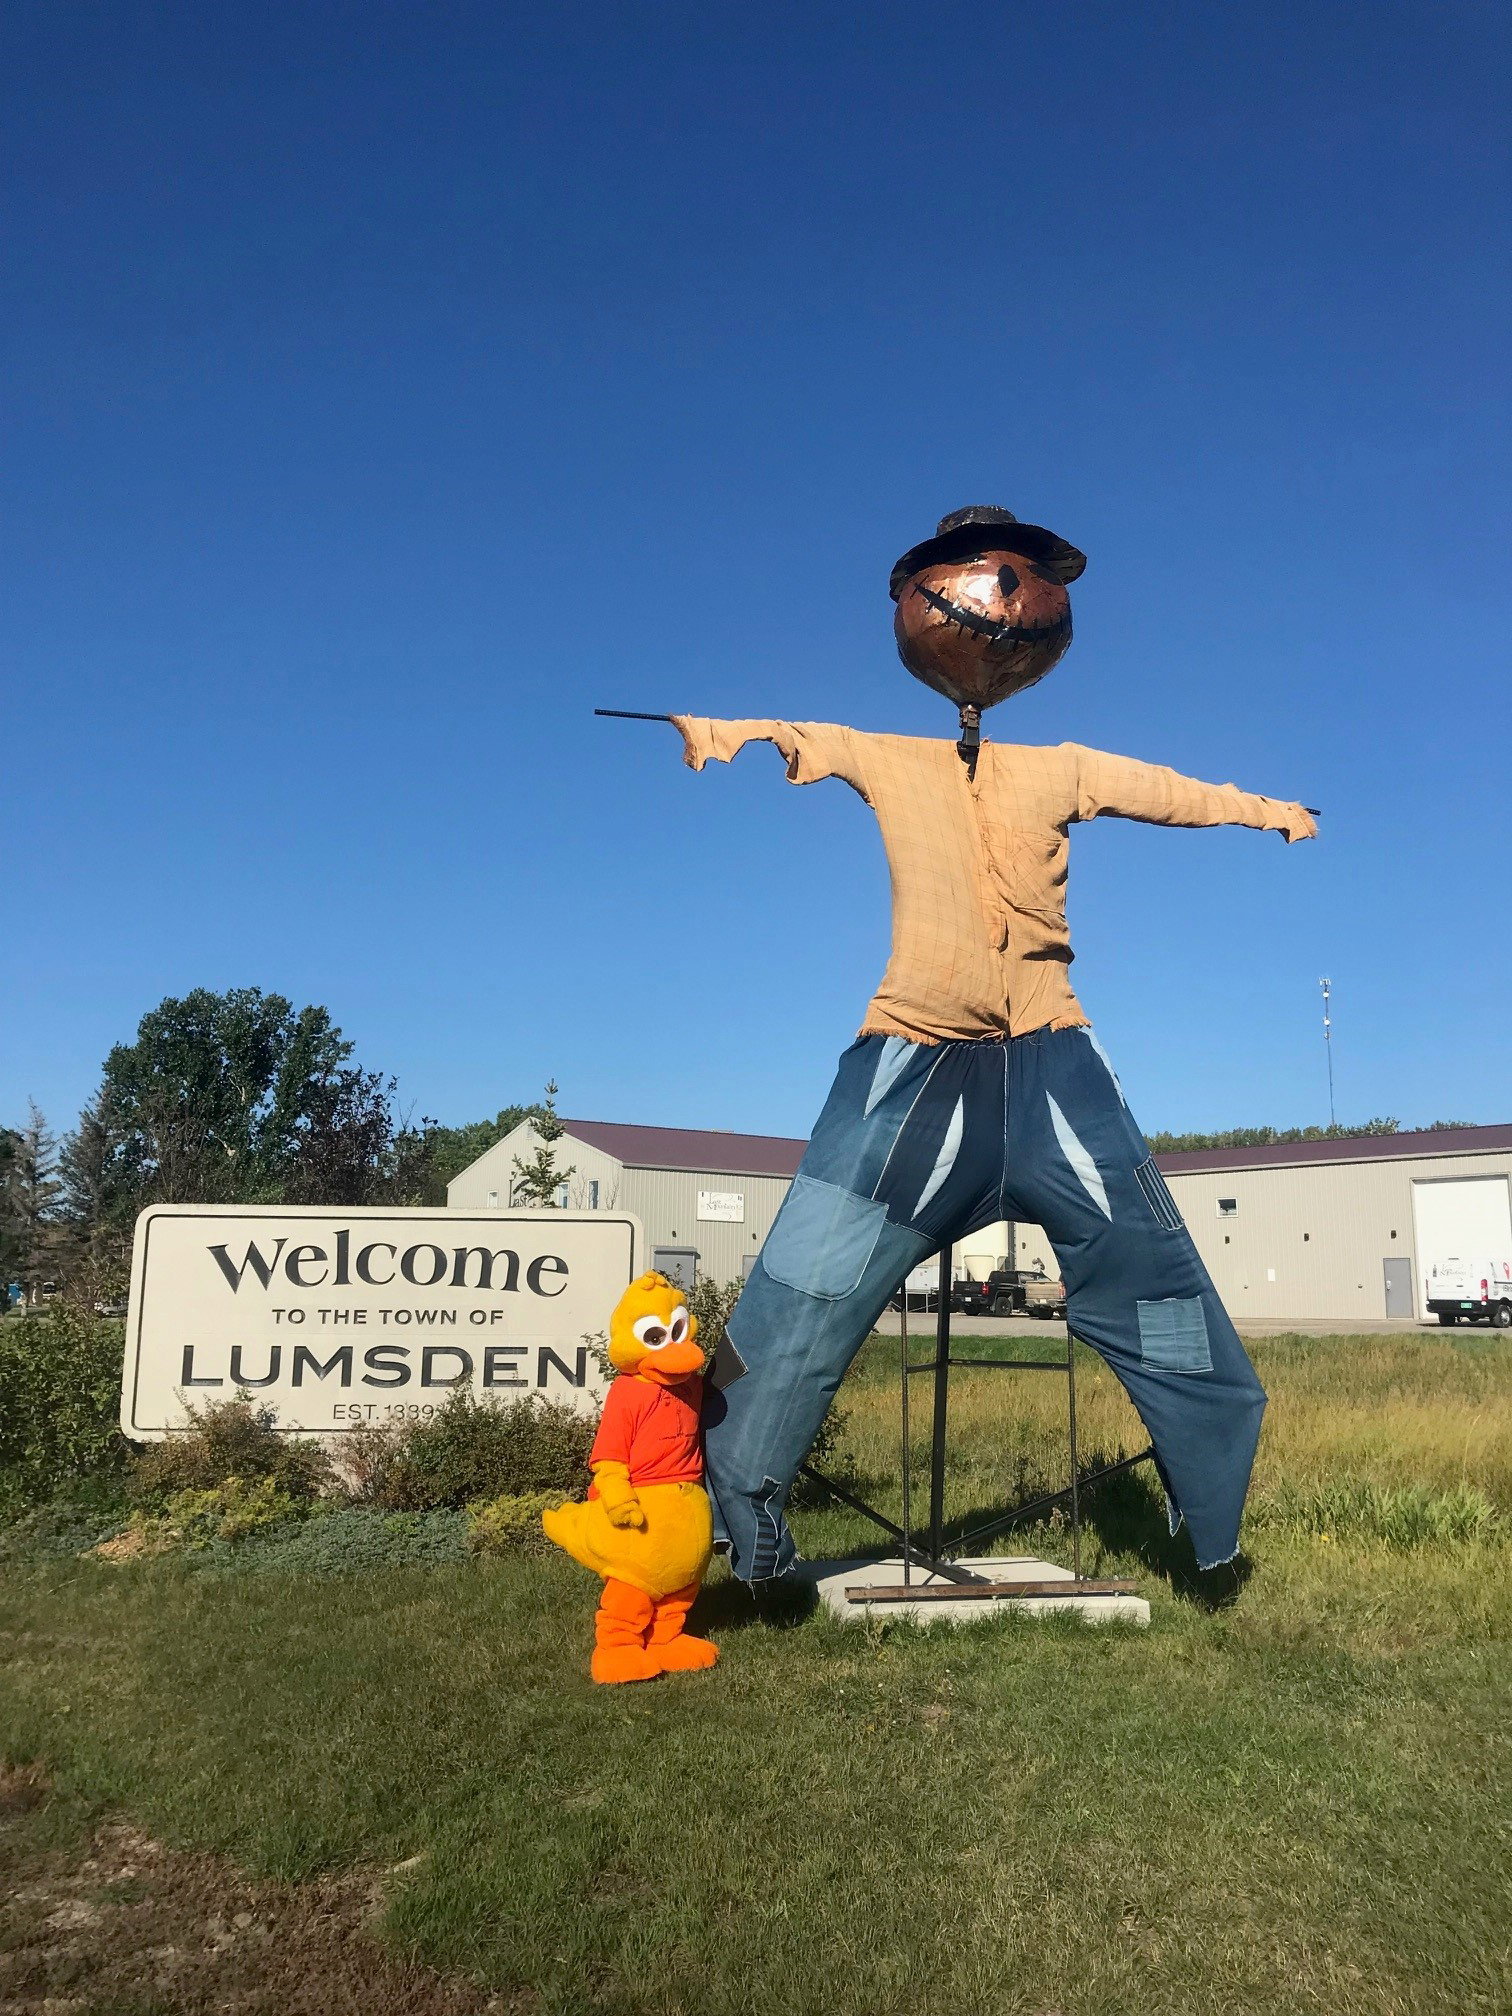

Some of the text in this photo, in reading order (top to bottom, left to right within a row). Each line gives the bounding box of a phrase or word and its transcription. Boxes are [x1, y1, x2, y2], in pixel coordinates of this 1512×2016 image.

[206, 1229, 569, 1297] Welcome
[272, 1309, 504, 1326] TO THE TOWN OF
[181, 1344, 587, 1388] LUMSDEN
[333, 1403, 380, 1420] EST.
